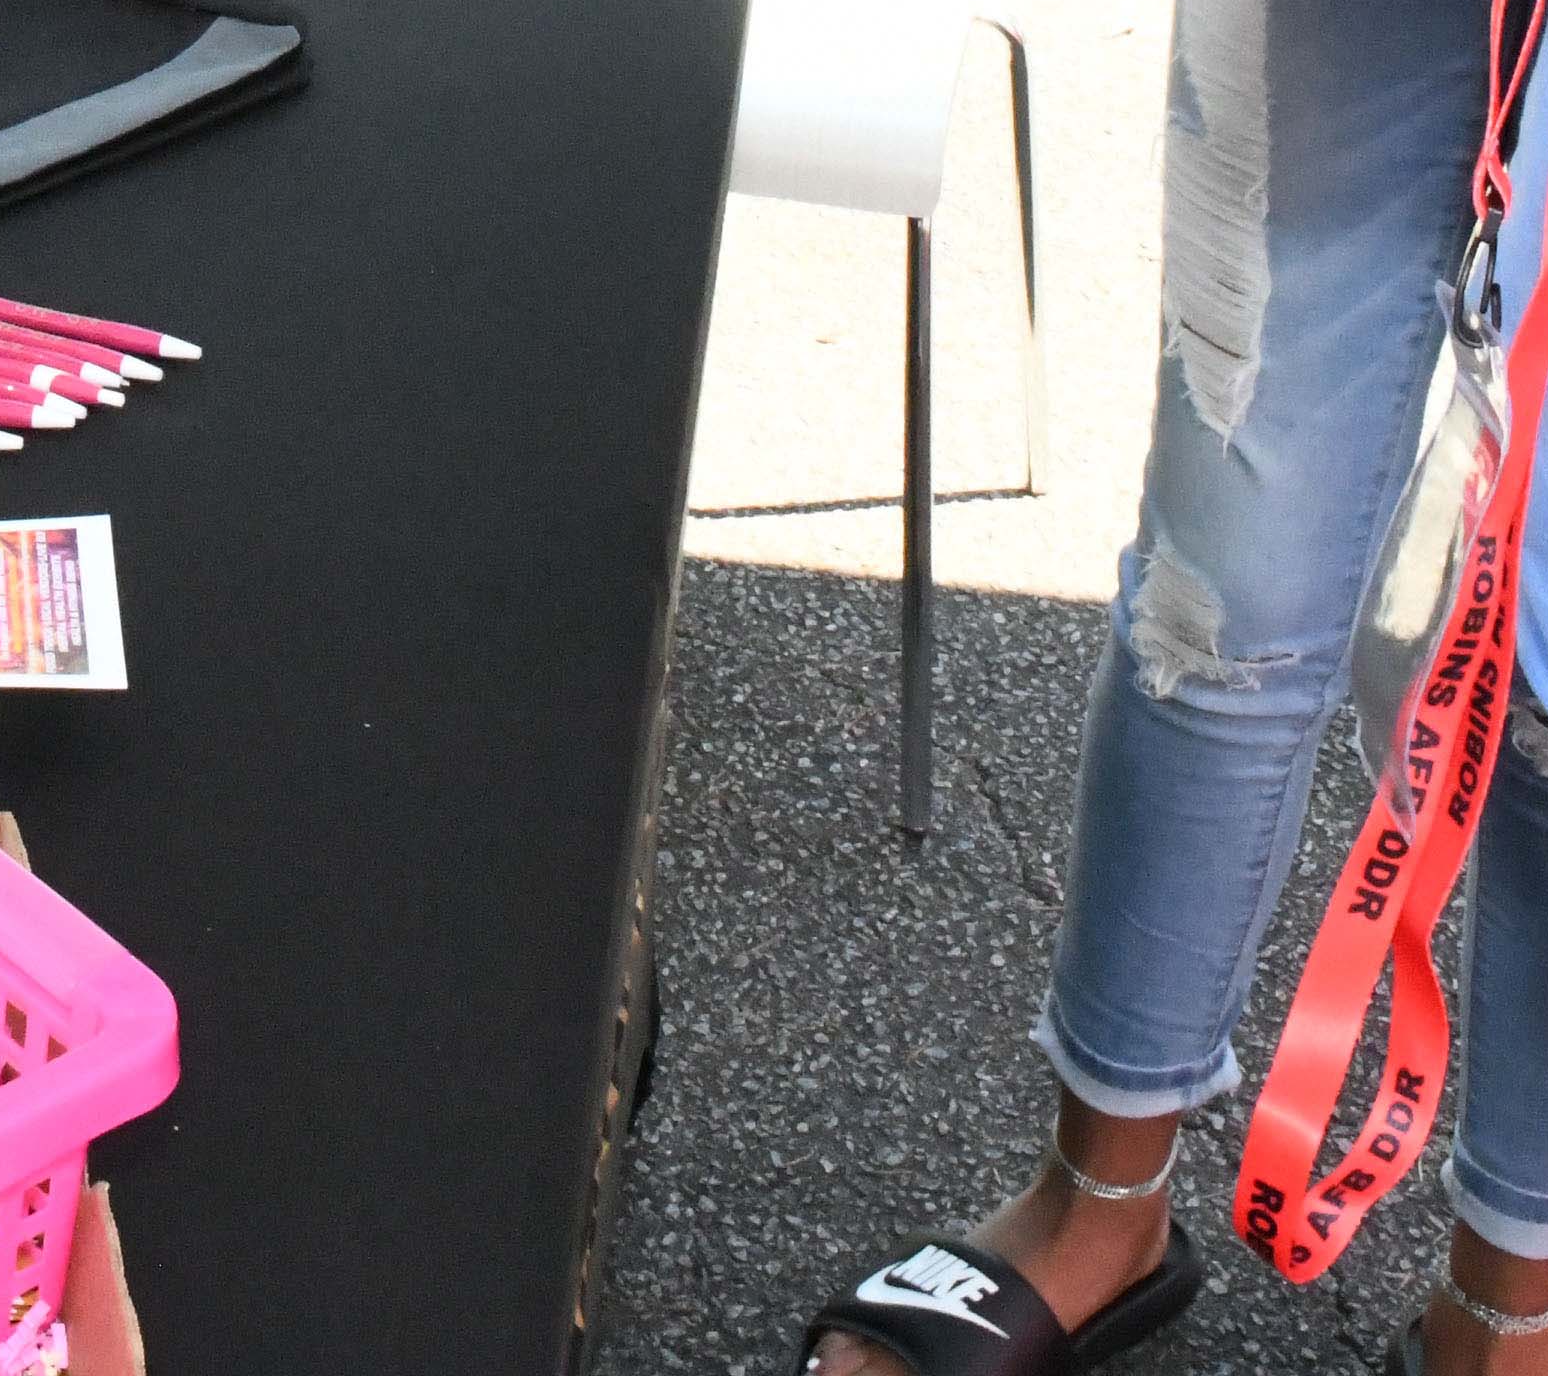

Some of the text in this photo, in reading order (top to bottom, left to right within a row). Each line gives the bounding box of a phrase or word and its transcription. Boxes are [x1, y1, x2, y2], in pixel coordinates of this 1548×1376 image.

[1428, 536, 1497, 709] ROBINS
[1307, 1066, 1425, 1242] AFB DDR
[891, 1243, 1000, 1304] NIKE
